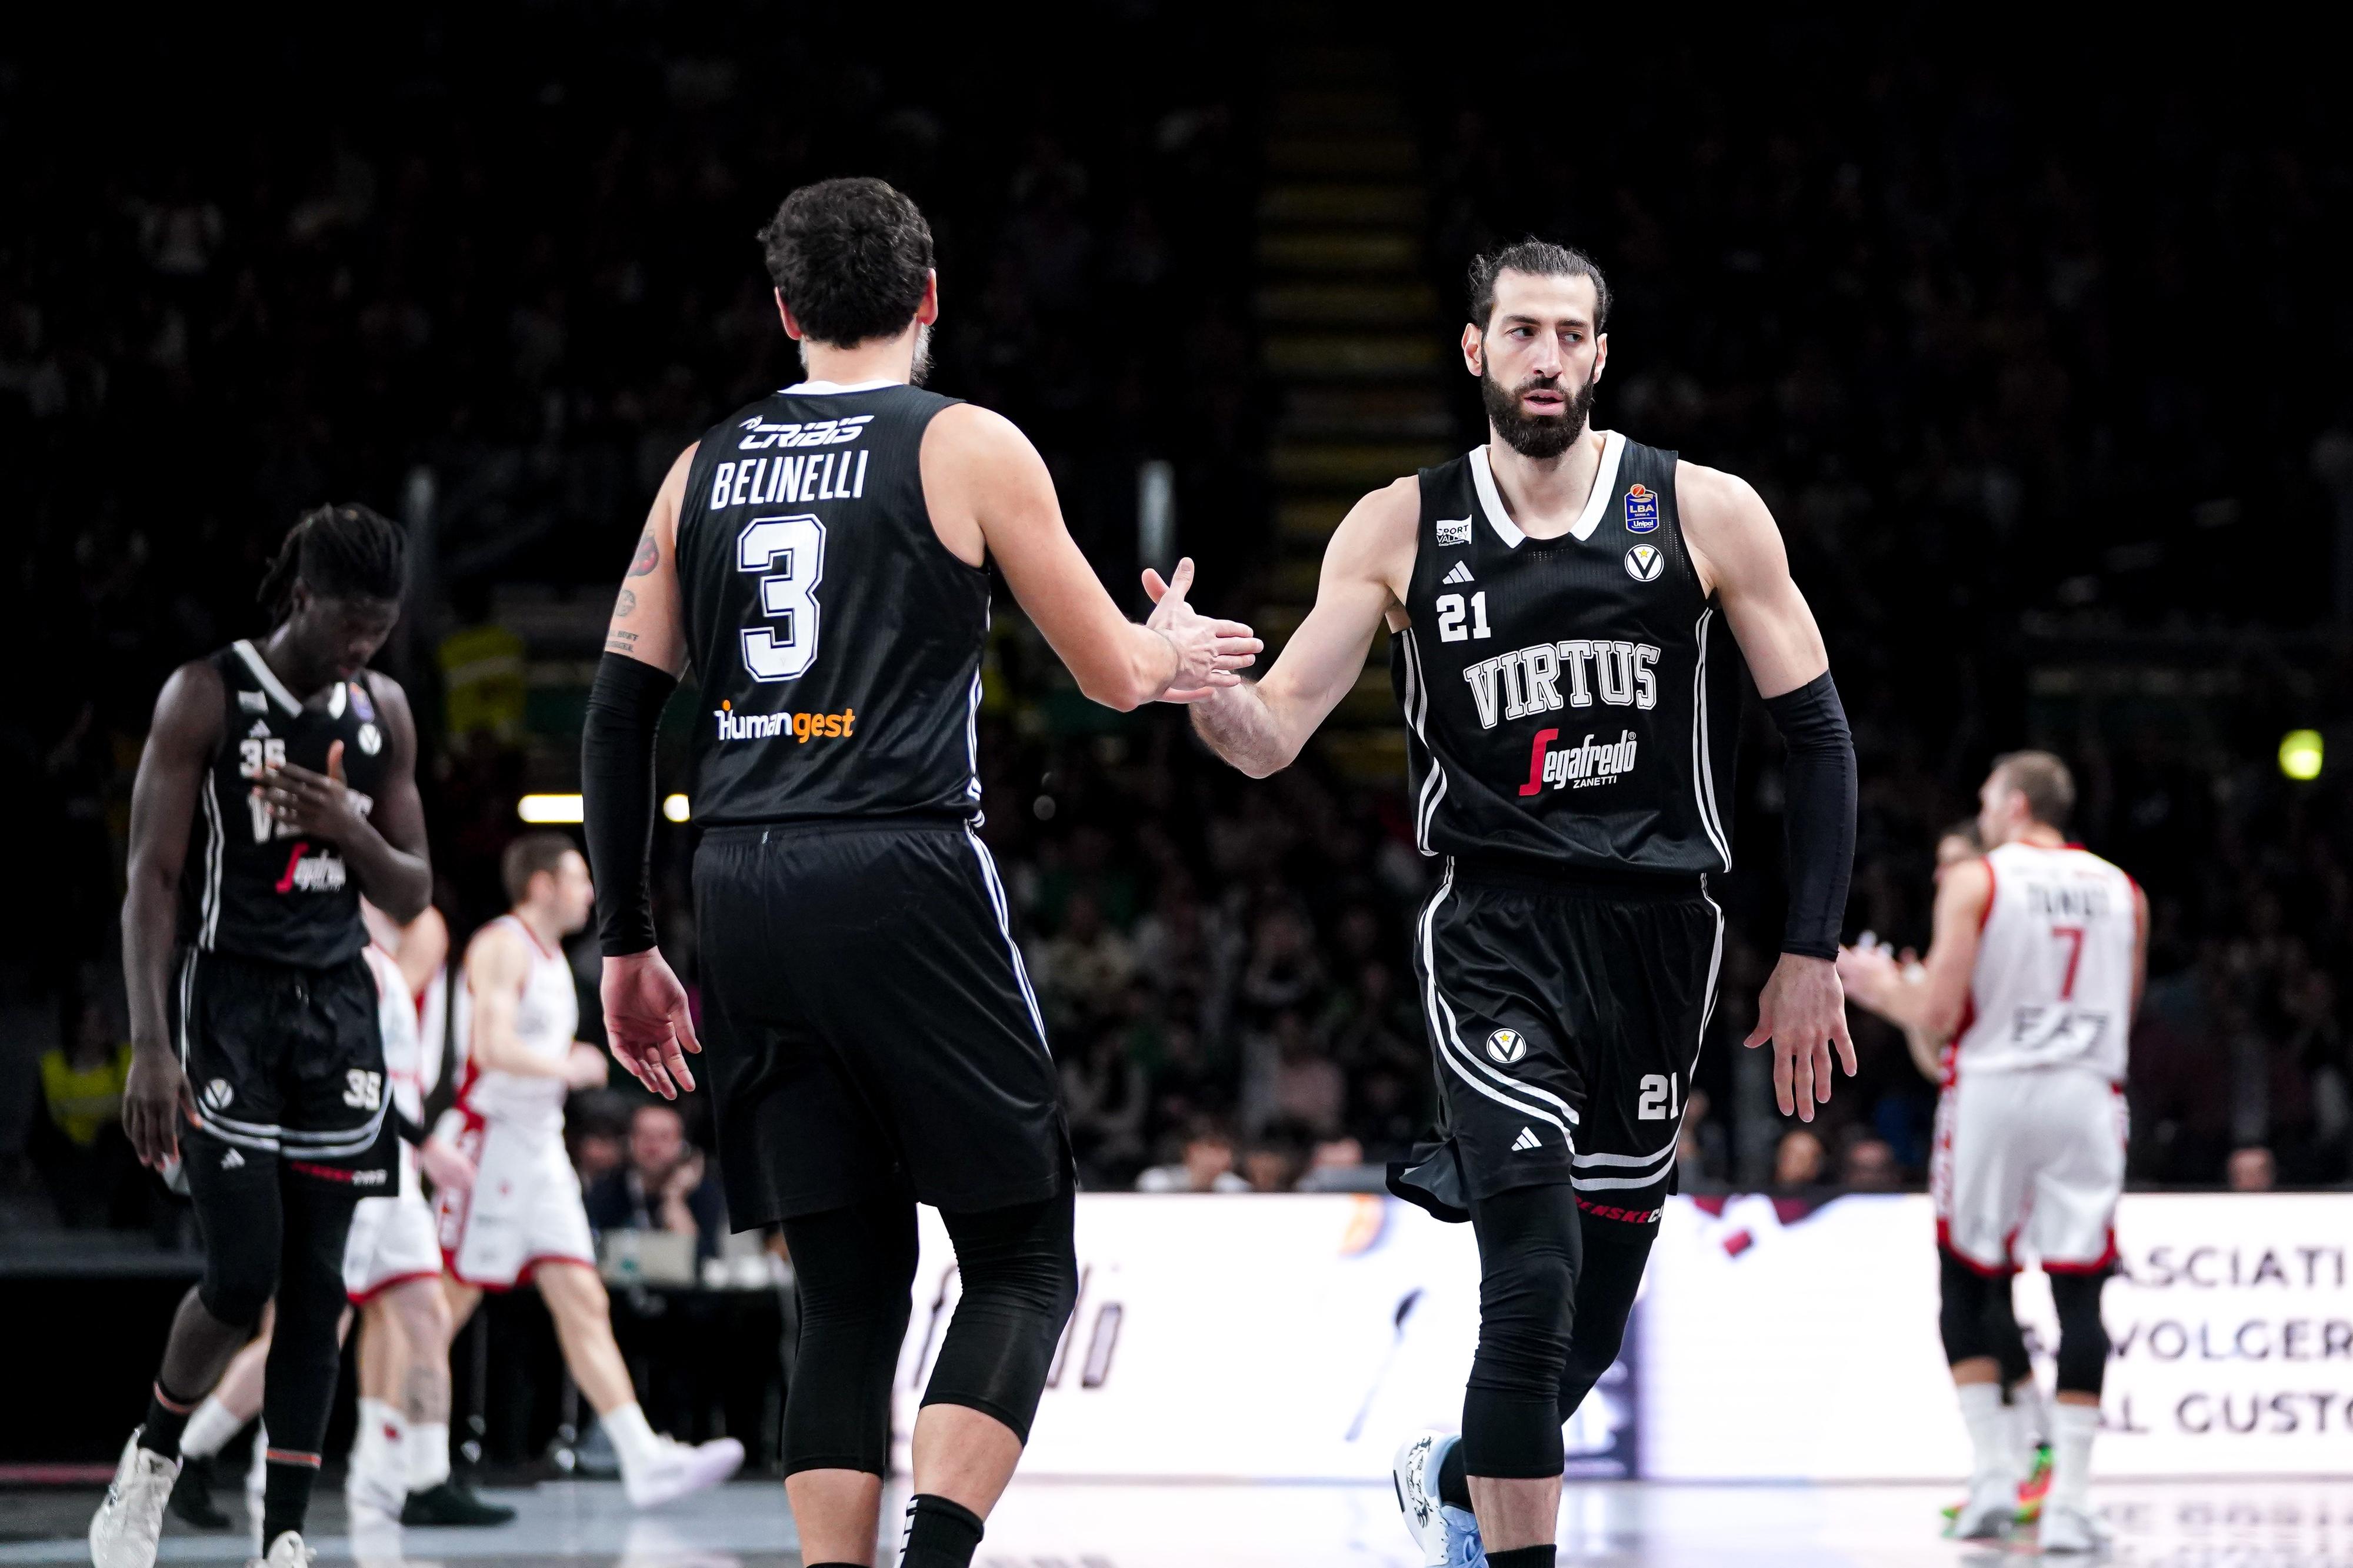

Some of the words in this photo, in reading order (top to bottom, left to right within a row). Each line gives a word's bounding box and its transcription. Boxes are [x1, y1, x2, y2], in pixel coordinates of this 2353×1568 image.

[738, 415, 875, 450] CRIBIS
[709, 449, 869, 510] BELINELLI
[1436, 524, 1469, 536] SPORT
[1629, 504, 1655, 513] LBA
[1632, 519, 1654, 528] Unipol
[736, 513, 826, 683] 3
[1436, 591, 1491, 643] 21
[1463, 639, 1661, 730] VIRTUS
[713, 700, 856, 743] Humangest
[1519, 728, 1638, 796] Segafredo
[1573, 775, 1617, 789] ZANETTI
[2052, 922, 2085, 1002] 7
[1638, 1072, 1678, 1120] 21
[2177, 1392, 2353, 1434] GUST
